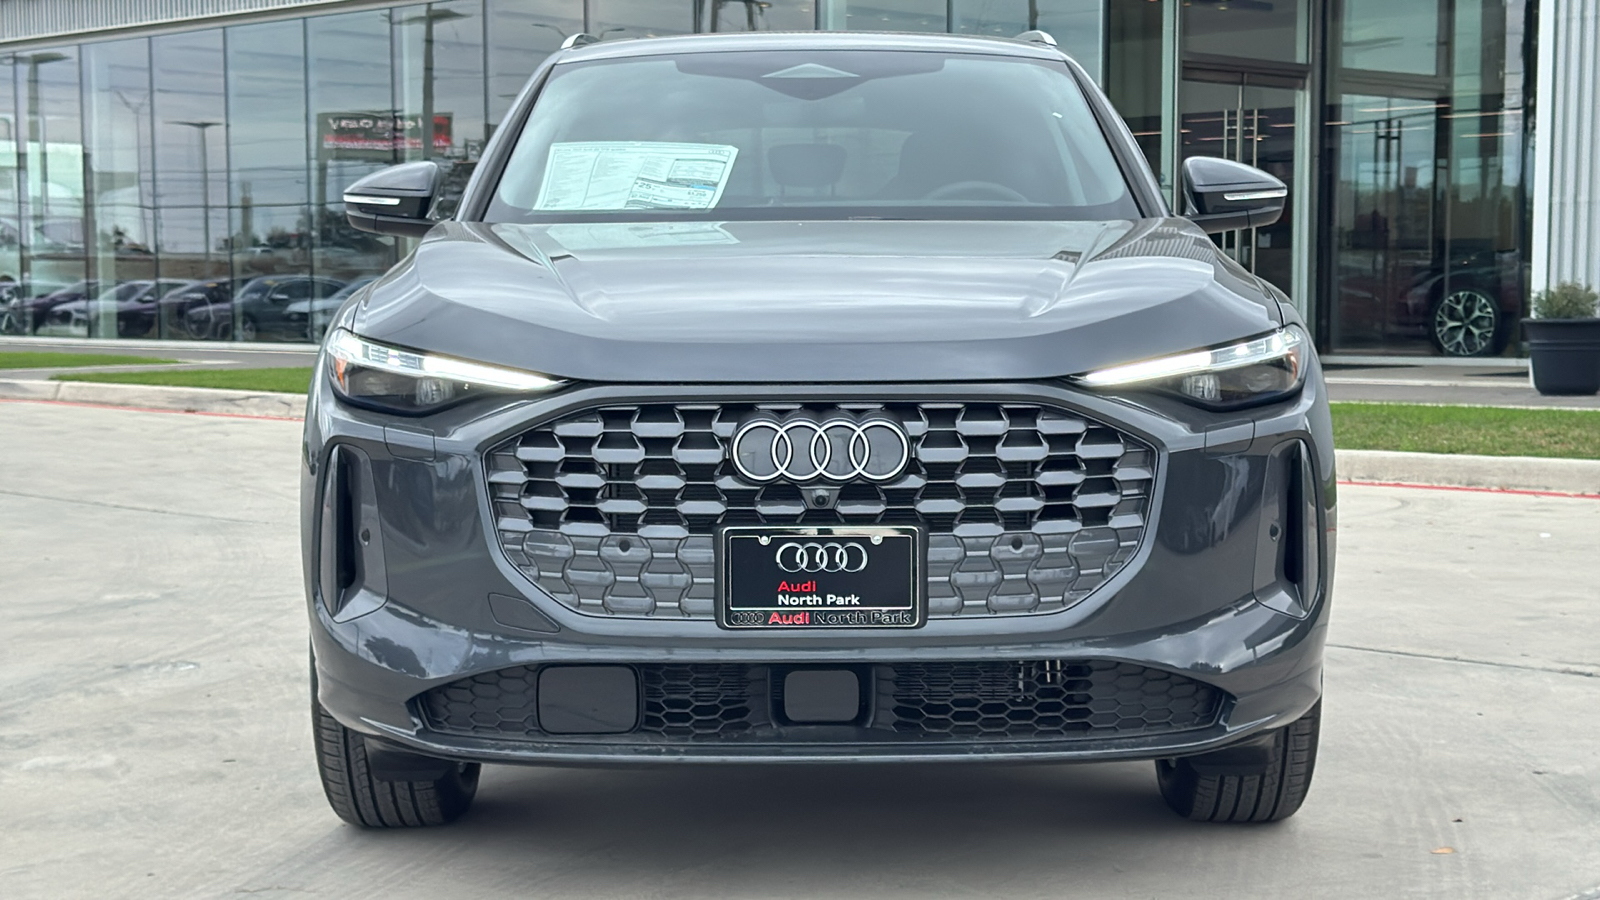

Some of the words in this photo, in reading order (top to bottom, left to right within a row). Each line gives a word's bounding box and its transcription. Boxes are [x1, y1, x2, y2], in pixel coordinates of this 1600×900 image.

[777, 580, 817, 592] Audi
[777, 594, 823, 606] North
[826, 594, 860, 606] Park
[768, 611, 810, 625] Audi
[814, 612, 867, 625] North
[870, 611, 912, 625] Park
